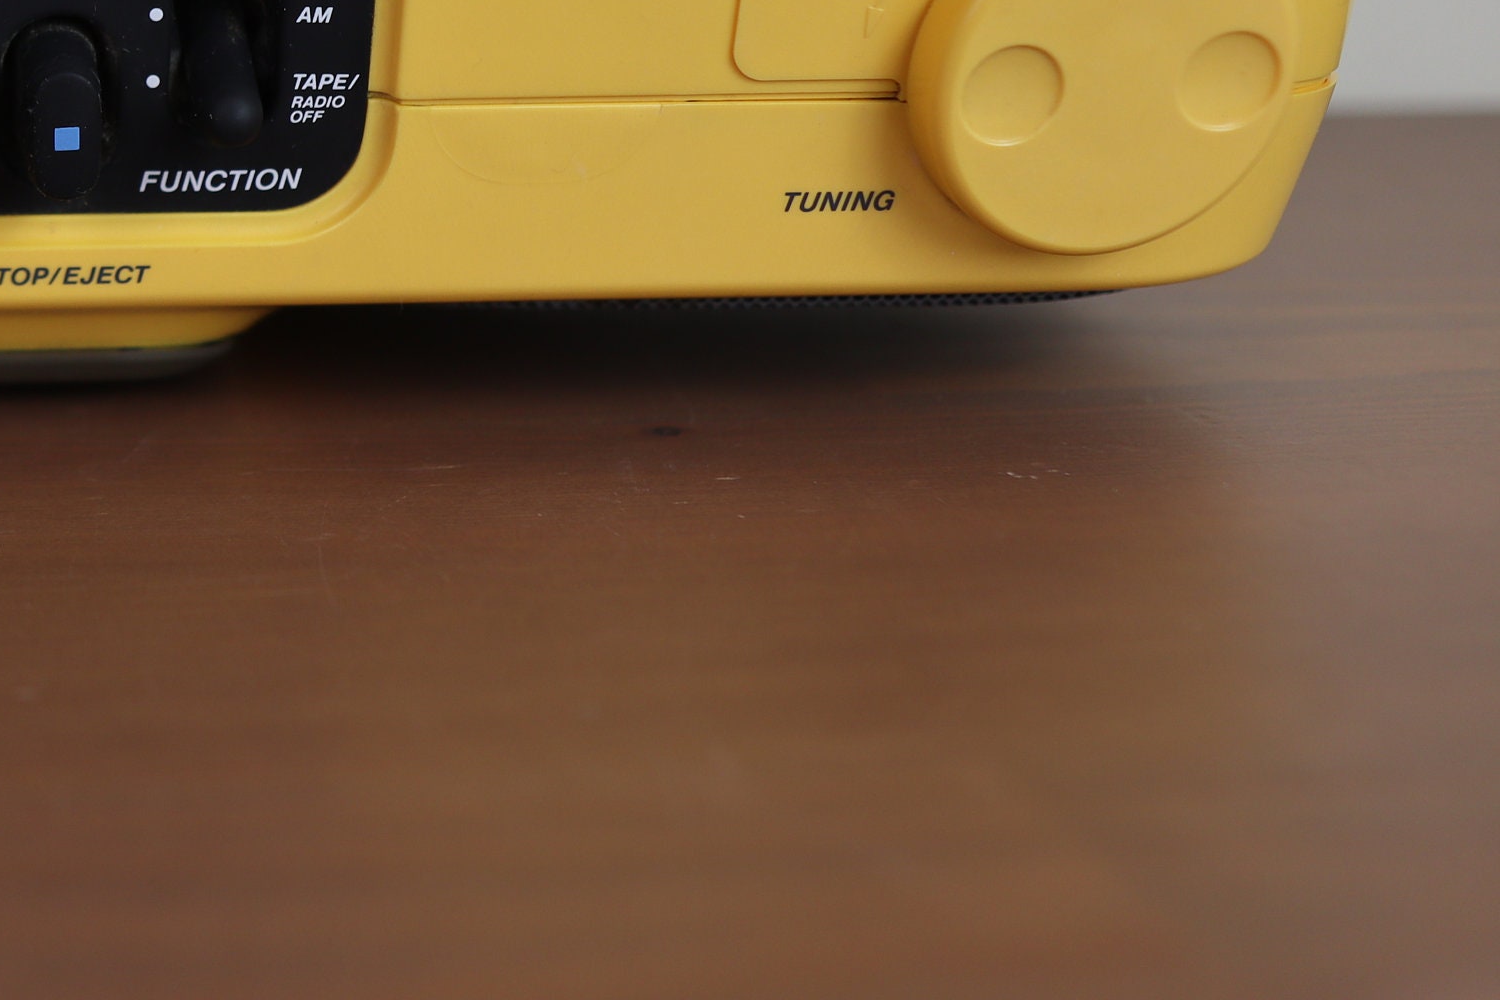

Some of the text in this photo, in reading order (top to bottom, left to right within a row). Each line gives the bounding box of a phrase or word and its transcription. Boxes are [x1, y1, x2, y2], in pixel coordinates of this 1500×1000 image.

[295, 5, 335, 24] AM
[291, 72, 361, 92] TAPE/
[290, 95, 347, 109] RADIO
[288, 109, 326, 124] OFF
[138, 167, 304, 194] FUNCTION
[783, 189, 896, 213] TUNING
